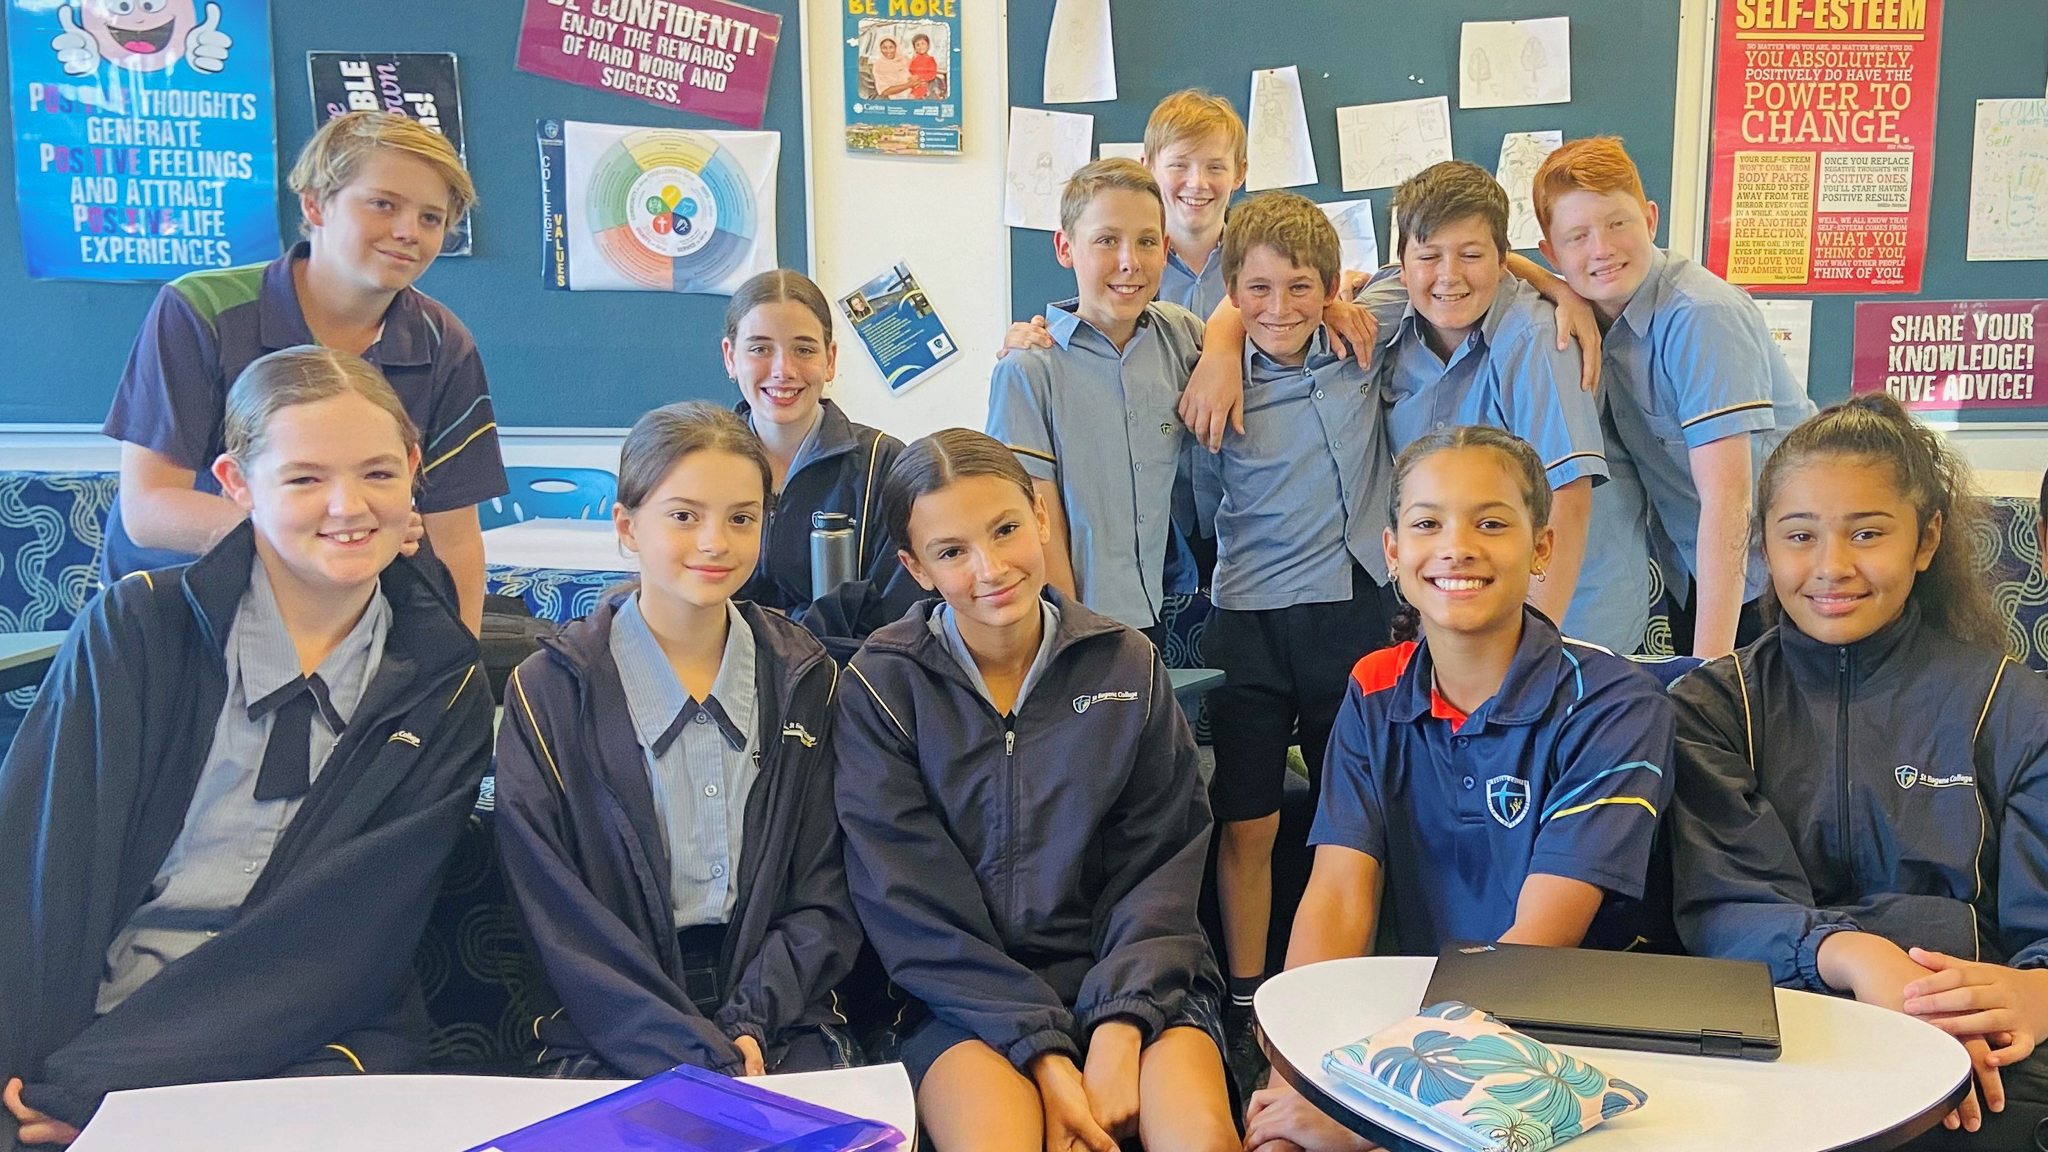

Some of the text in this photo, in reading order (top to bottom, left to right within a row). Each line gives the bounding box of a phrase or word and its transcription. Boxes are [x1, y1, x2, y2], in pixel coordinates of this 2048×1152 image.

[889, 0, 956, 17] MORE
[1736, 0, 1926, 30] SELF-ESTEEM
[592, 0, 760, 56] CONFIDENT!
[560, 11, 737, 73] ENJOY THE REWARDS
[562, 34, 728, 93] OF HARD WORK AND
[1745, 51, 1913, 73] YOU ABSOLUTELY,
[1745, 68, 1912, 81] POSITIVELY DO HAVE THE
[600, 67, 682, 104] SUCCESS.
[1744, 83, 1911, 110] POWER TO
[141, 90, 256, 120] THOUGHTS
[87, 117, 201, 147] GENERATE
[1741, 110, 1909, 144] CHANGE.
[150, 151, 253, 179] FEELINGS
[1739, 173, 1810, 183] BODY PARTS.
[71, 177, 226, 208] AND ATTRACT
[1824, 174, 1908, 185] POSITIVE ONES,
[541, 155, 553, 242] COLLEGE
[1737, 192, 1809, 200] AWAY FROM THE
[181, 209, 225, 236] LIFE
[1735, 228, 1807, 239] REFLECTION,
[1736, 218, 1808, 227] FOR ANOTHER
[80, 236, 231, 267] EXPERIENCES
[554, 214, 566, 287] VALUES
[1817, 232, 1907, 246] WHAT YOU
[1734, 257, 1804, 265] WHO LOVE YOU
[1815, 247, 1906, 260] THINK OF YOU,
[1814, 268, 1904, 278] THINK OF YOU.
[1890, 313, 2034, 343] SHARE YOUR
[1888, 344, 2034, 373] KNOWLEDGE!
[1885, 374, 2034, 401] GIVE ADVICE!
